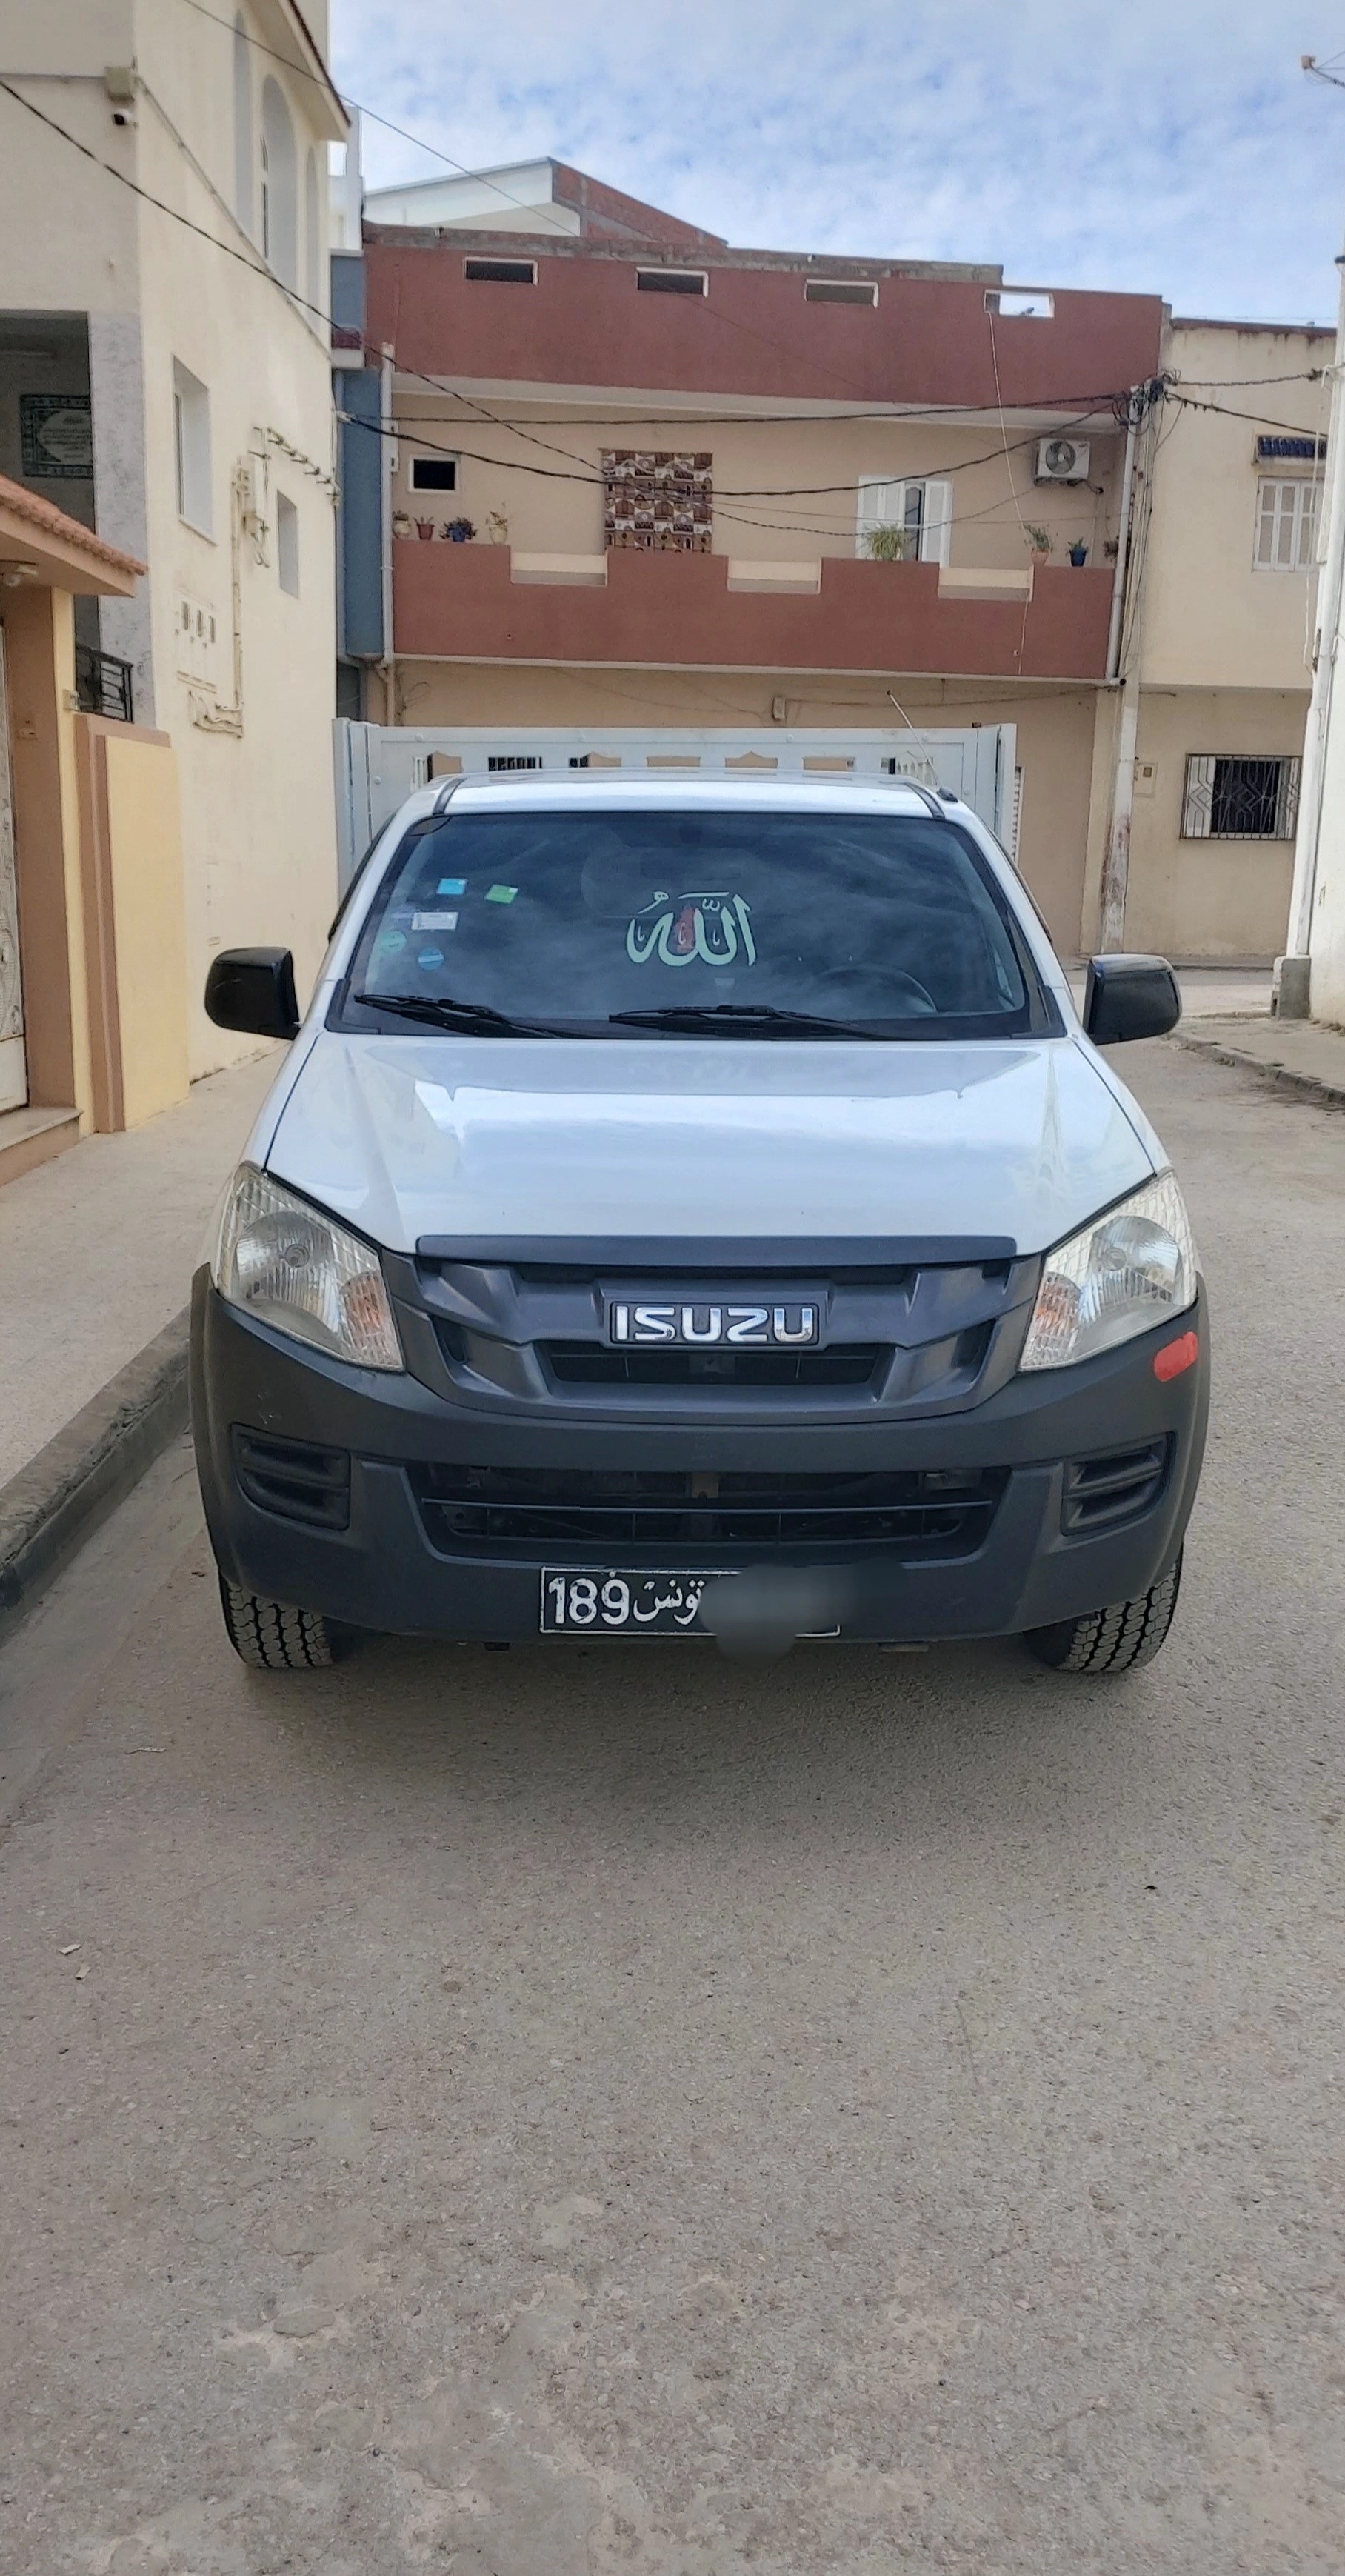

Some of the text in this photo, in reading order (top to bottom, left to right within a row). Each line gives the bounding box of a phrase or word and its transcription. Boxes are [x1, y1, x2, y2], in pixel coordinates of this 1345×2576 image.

[615, 1305, 814, 1343] ISUZU
[548, 1577, 630, 1625] 189
[633, 1579, 705, 1626] تونس
